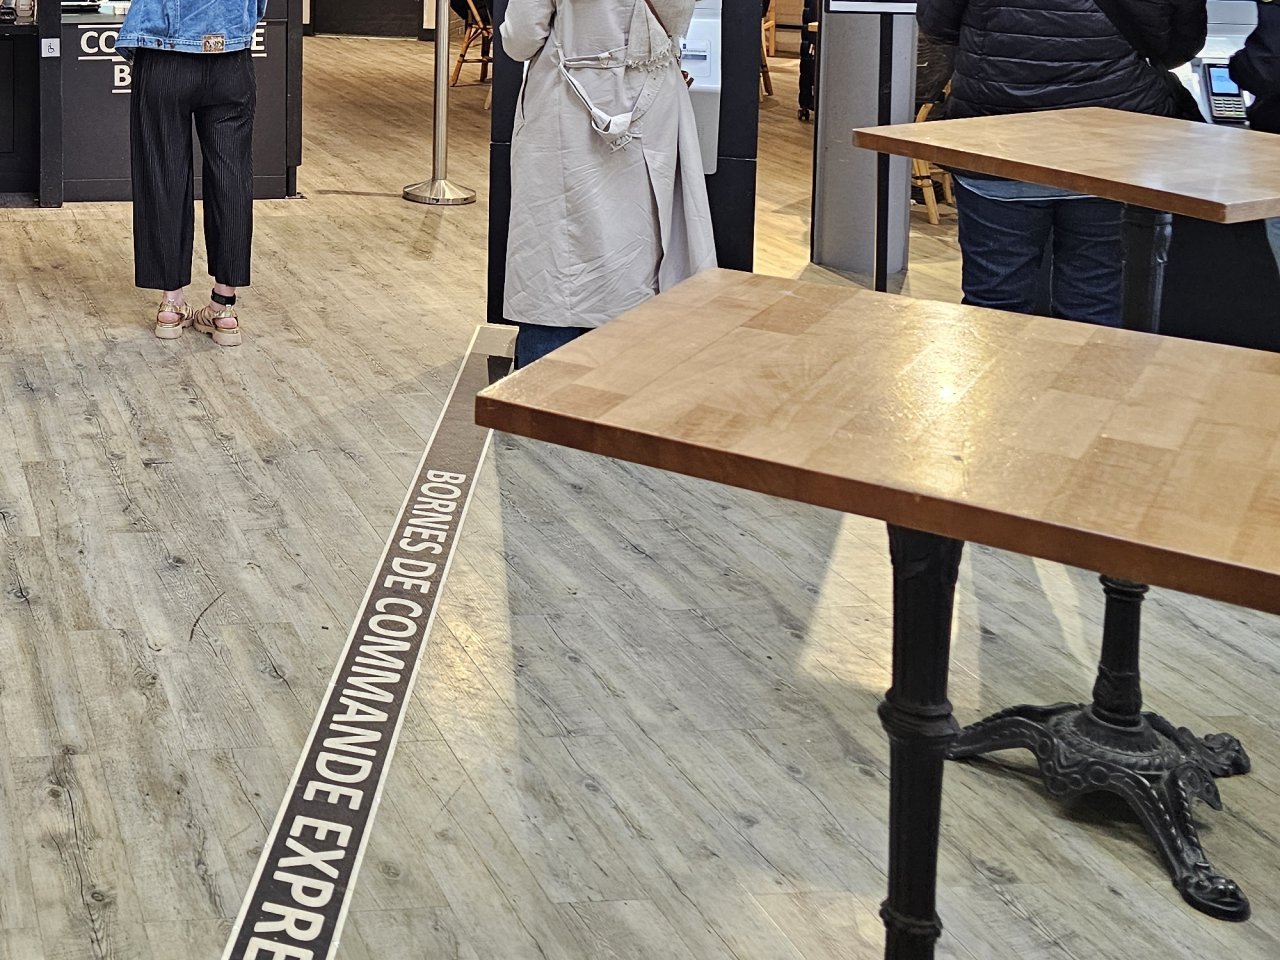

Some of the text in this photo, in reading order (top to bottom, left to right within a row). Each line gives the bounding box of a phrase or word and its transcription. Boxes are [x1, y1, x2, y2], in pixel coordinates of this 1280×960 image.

[242, 468, 467, 960] BORNES DE COMMANDE EXPRE
